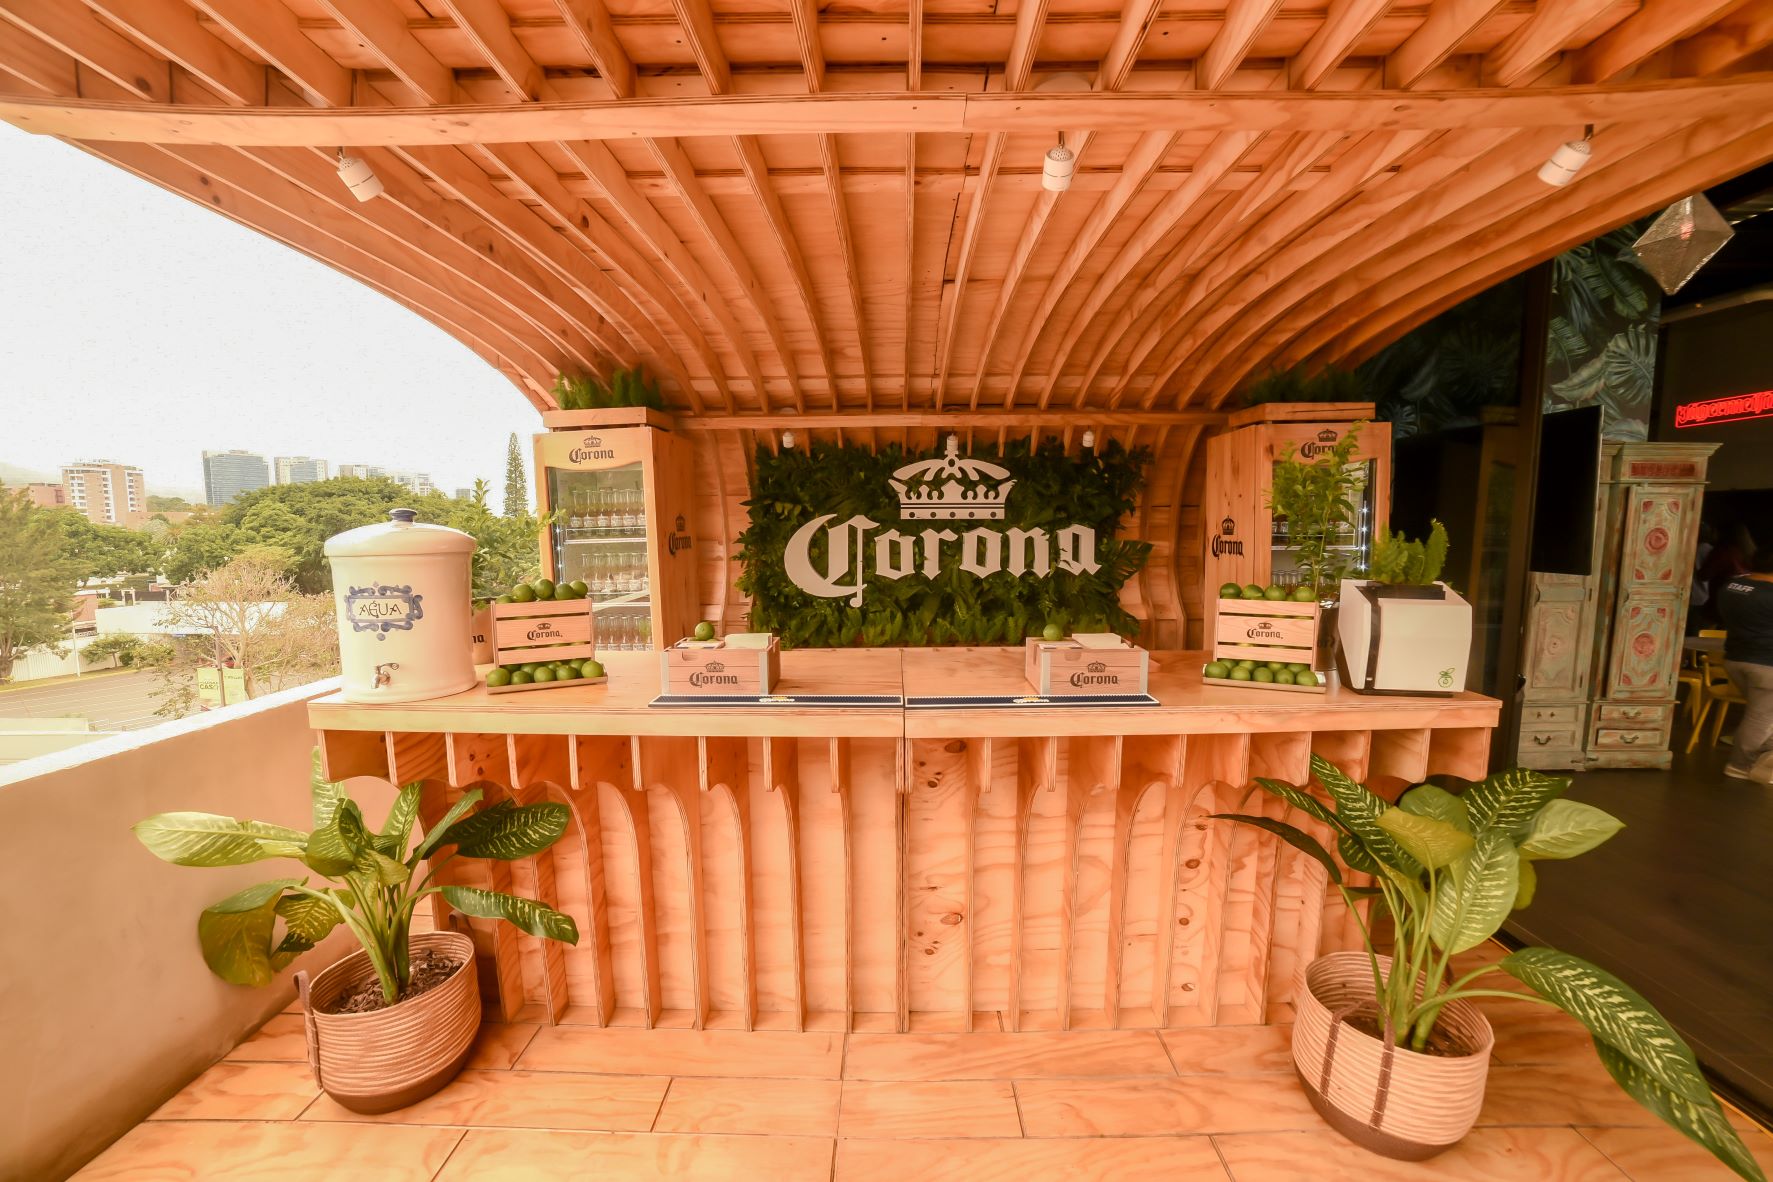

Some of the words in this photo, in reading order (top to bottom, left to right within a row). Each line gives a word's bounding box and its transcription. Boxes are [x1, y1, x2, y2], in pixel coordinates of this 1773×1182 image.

[568, 448, 615, 465] Corona
[668, 531, 693, 558] Corona
[1211, 534, 1245, 561] Corona
[783, 513, 1102, 608] Corona
[1728, 582, 1755, 593] STAFF
[526, 630, 562, 642] Corona
[1246, 628, 1282, 640] Corona
[688, 672, 738, 688] Corona
[1069, 672, 1119, 688] Corona
